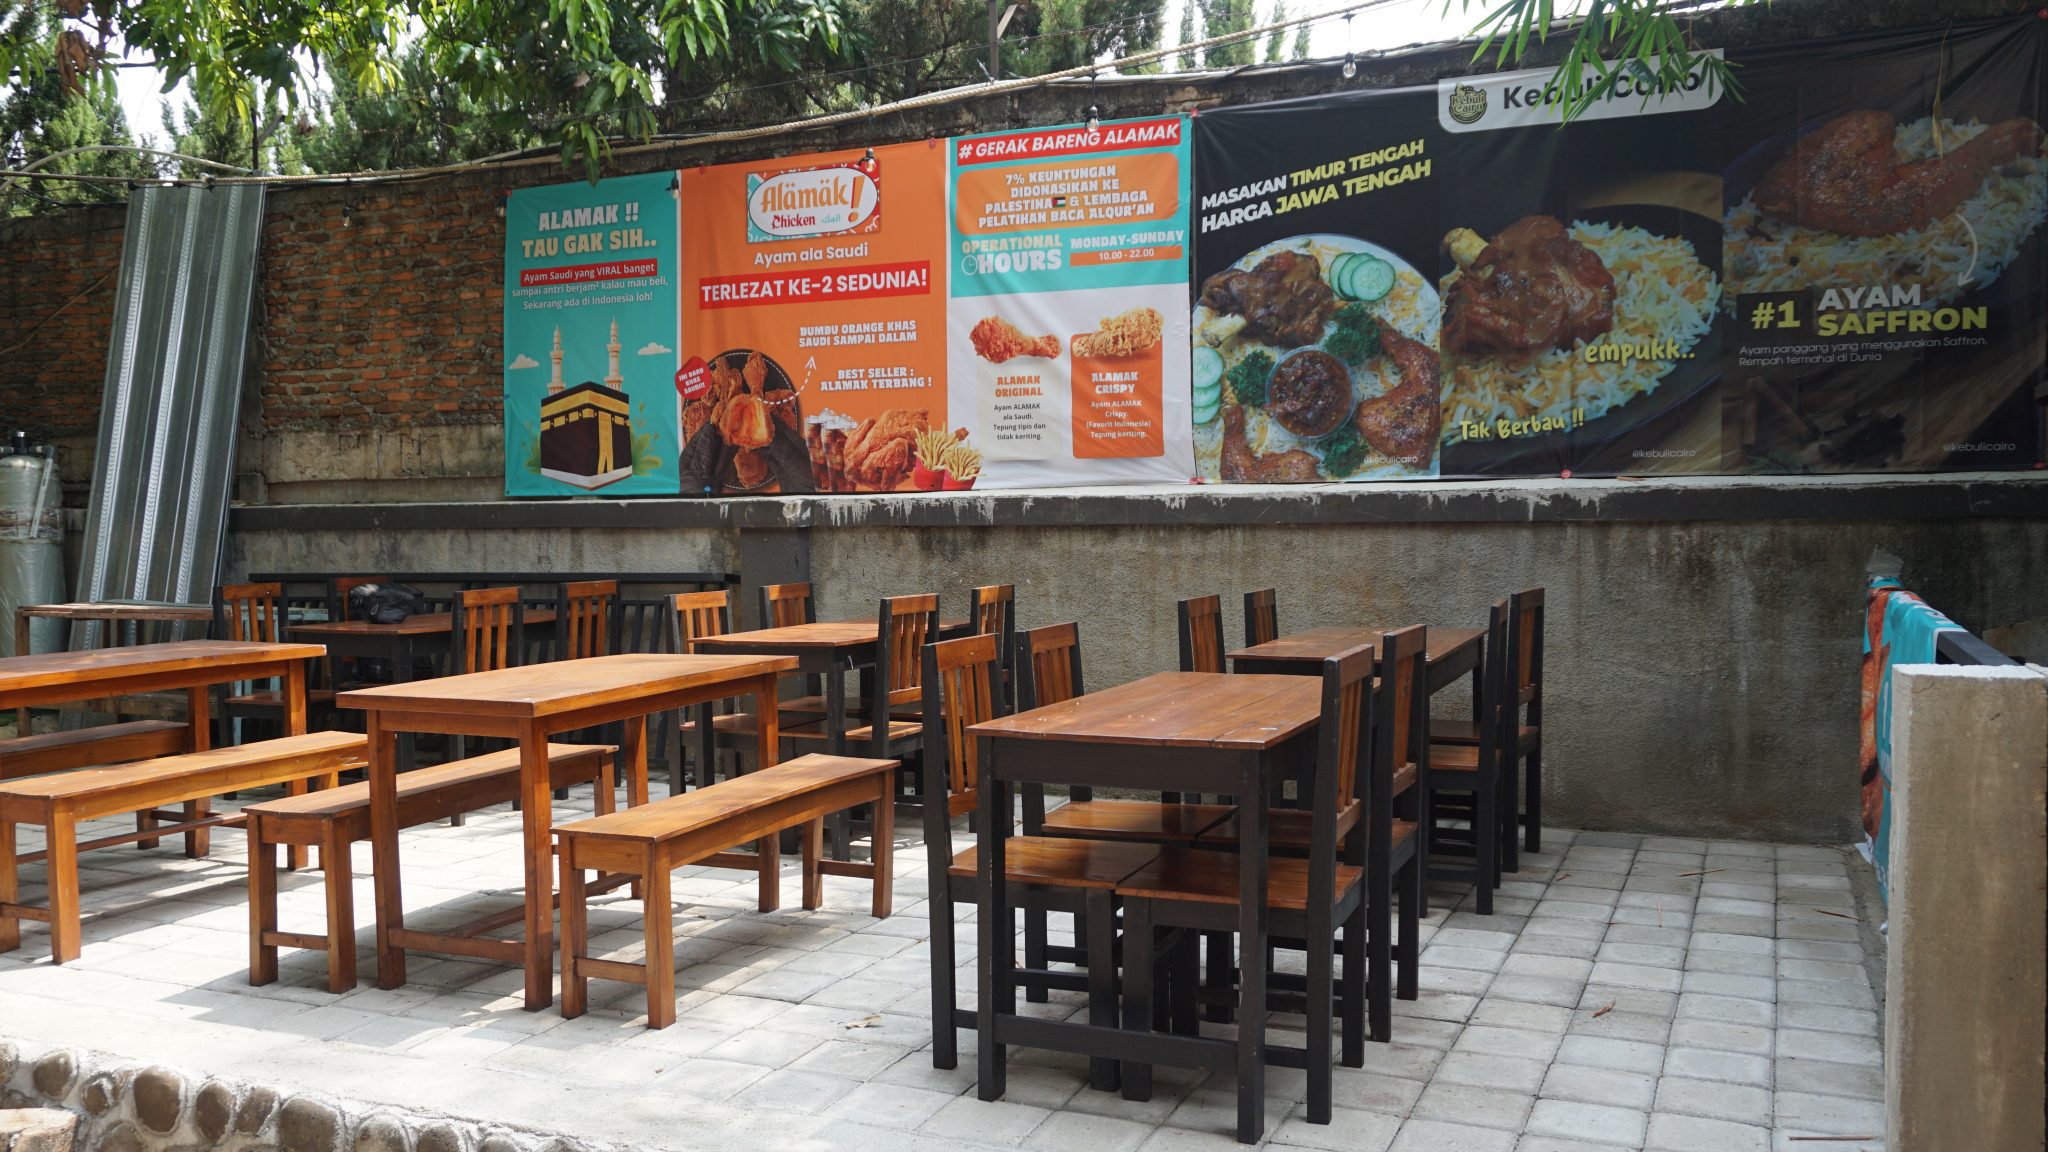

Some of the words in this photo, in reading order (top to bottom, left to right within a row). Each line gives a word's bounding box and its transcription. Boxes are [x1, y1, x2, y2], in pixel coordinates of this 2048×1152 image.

[1453, 103, 1484, 114] Cairo
[959, 144, 972, 158] #
[976, 138, 1027, 157] GERAK
[1032, 132, 1100, 151] BARENG
[1104, 123, 1180, 145] ALAMAK
[1006, 174, 1024, 185] 7%
[1029, 166, 1116, 183] KEUNTUNGAN
[1201, 175, 1287, 210] MASAKAN
[1290, 161, 1345, 187] TIMUR
[1349, 138, 1424, 171] TENGAH
[1011, 181, 1098, 198] DIDONASIKAN
[1102, 179, 1119, 190] KE
[1202, 201, 1273, 233] HARGA
[1275, 184, 1339, 214] JAWA
[1342, 159, 1431, 196] TENGAH
[986, 198, 1052, 214] PALESTINA
[1070, 196, 1079, 206] &
[1084, 191, 1147, 205] LEMBAGA
[538, 204, 618, 231] ALAMAK
[625, 202, 639, 222] !!
[772, 214, 815, 229] Chicken
[978, 212, 1046, 228] PELATIHAN
[1051, 209, 1084, 222] BACA
[522, 237, 558, 258] TAU
[564, 233, 603, 255] GAK
[610, 228, 657, 250] SIH..
[962, 234, 1062, 253] OPERATIONAL
[1071, 230, 1184, 249] MONDAY-SUNDAY
[754, 251, 796, 268] Ayam
[800, 247, 822, 260] ala
[826, 242, 868, 259] Saudi
[978, 249, 1062, 274] HOURS
[1099, 251, 1122, 261] 10.00
[1130, 248, 1154, 258] 22.00
[524, 273, 547, 284] Ayam
[550, 270, 572, 280] Saudi
[575, 269, 594, 280] yang
[597, 266, 621, 275] VIRAL
[624, 263, 655, 274] banget
[512, 287, 541, 298] sampai
[543, 284, 563, 295] antri
[602, 280, 624, 289] kalau
[650, 277, 668, 287] beli,
[702, 280, 784, 302] TERLEZAT
[789, 275, 832, 296] KE-2
[836, 268, 927, 292] SEDUNIA!
[524, 299, 562, 310] Sekarang
[564, 299, 579, 307] ada
[582, 297, 590, 306] di
[592, 294, 634, 304] Indonesia
[636, 292, 653, 301] loh!
[1817, 284, 1921, 311] AYAM
[1751, 300, 1800, 329] #1
[1818, 306, 1988, 336] SAFFRON
[800, 324, 838, 336] BUMBU
[842, 322, 883, 334] ORANGE
[887, 320, 916, 331] KHAS
[799, 336, 830, 347] SAUDI
[834, 334, 875, 346] SAMPAI
[879, 331, 917, 343] DALAM
[1740, 346, 1771, 356] Ayam
[1773, 344, 1828, 354] panggang
[1831, 343, 1859, 352] yang
[1861, 338, 1940, 351] menggunakan
[1943, 336, 1988, 346] Saffron.
[1585, 336, 1695, 367] empukk..
[1740, 357, 1783, 367] Rempah
[1786, 355, 1834, 364] termahal
[1837, 353, 1848, 362] di
[1850, 352, 1882, 362] Dunia
[838, 369, 865, 380] BEST
[868, 367, 907, 378] SELLER
[997, 376, 1040, 385] ALAMAK
[1092, 371, 1138, 382] ALAMAK
[821, 380, 868, 391] ALAMAK
[872, 377, 924, 389] TERBANG
[995, 387, 1043, 397] ORIGINAL
[1095, 384, 1135, 394] CRISPY
[1105, 410, 1129, 419] Crispy.
[1460, 421, 1490, 440] Tak
[1498, 415, 1565, 439] Berbau
[1572, 407, 1584, 427] !!
[1632, 448, 1696, 458] @kebulicairo
[1943, 442, 2016, 452] @kebulicairo
